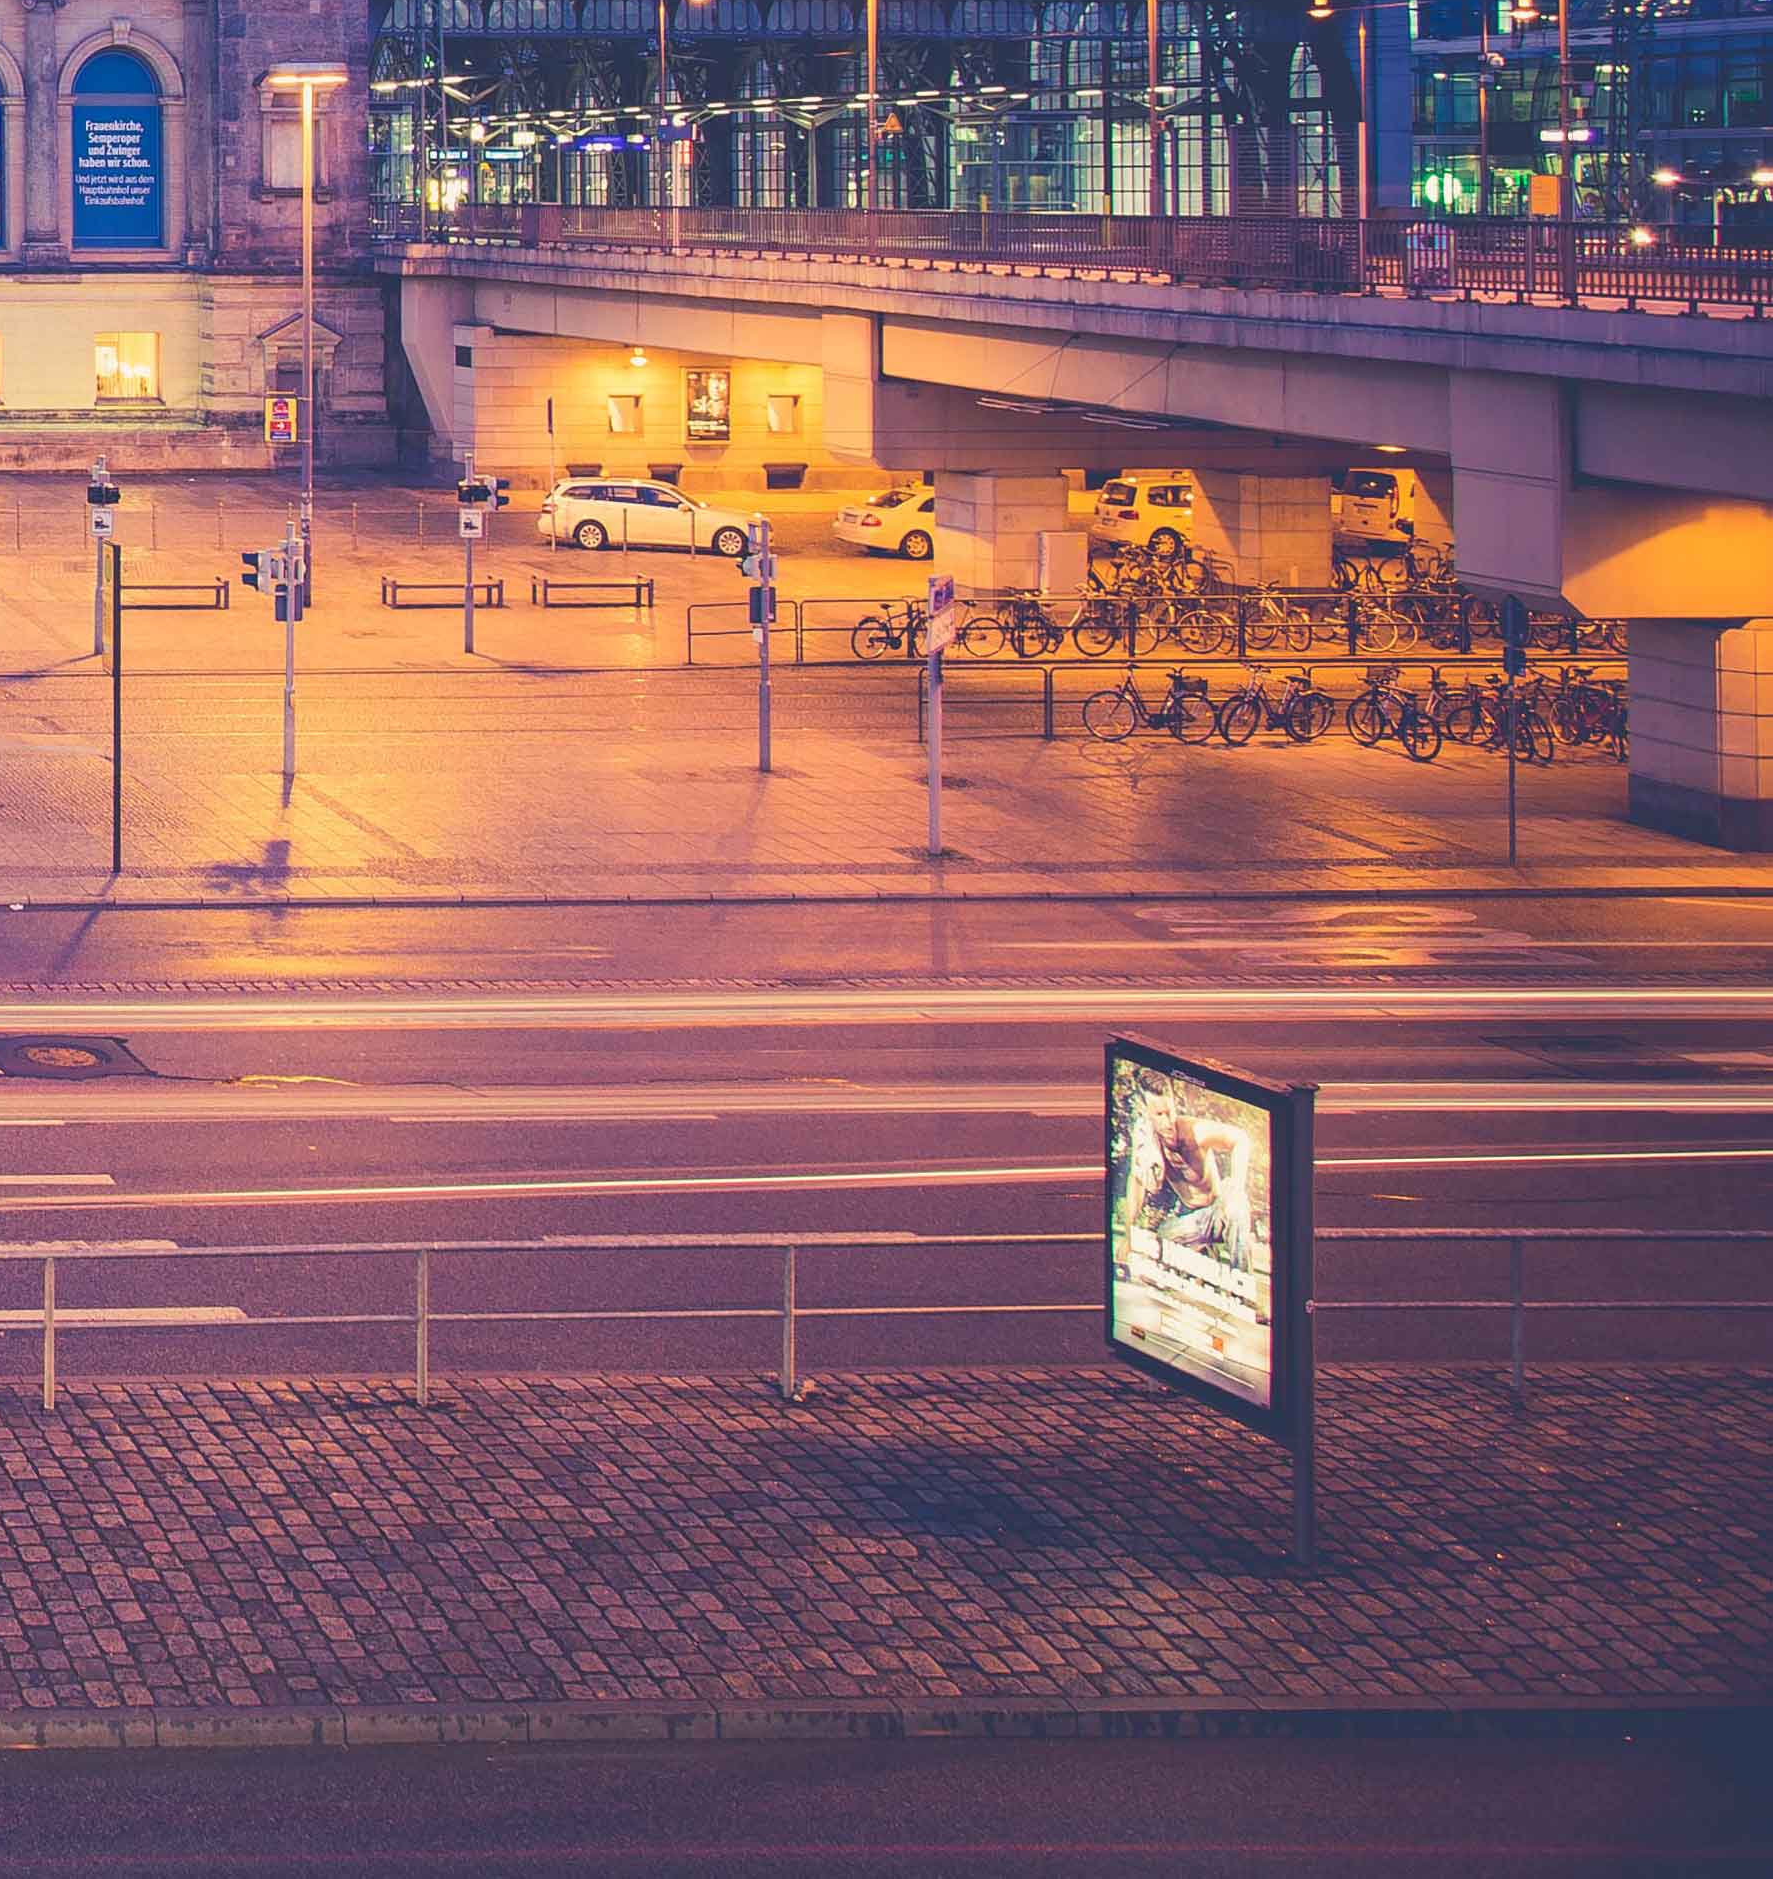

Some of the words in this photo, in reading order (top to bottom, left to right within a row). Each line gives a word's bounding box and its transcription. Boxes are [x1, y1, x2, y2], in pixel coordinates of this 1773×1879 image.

[85, 120, 144, 133] Frauenkirche,
[87, 132, 141, 146] Semperoper
[87, 145, 106, 155] und
[106, 144, 141, 158] Zwinger
[78, 157, 106, 168] haben
[107, 157, 121, 168] wir
[122, 157, 151, 168] schon.
[75, 174, 90, 183] Und
[108, 174, 124, 183] wird
[138, 174, 155, 183] dem
[79, 185, 130, 196] Hauptbahnhof
